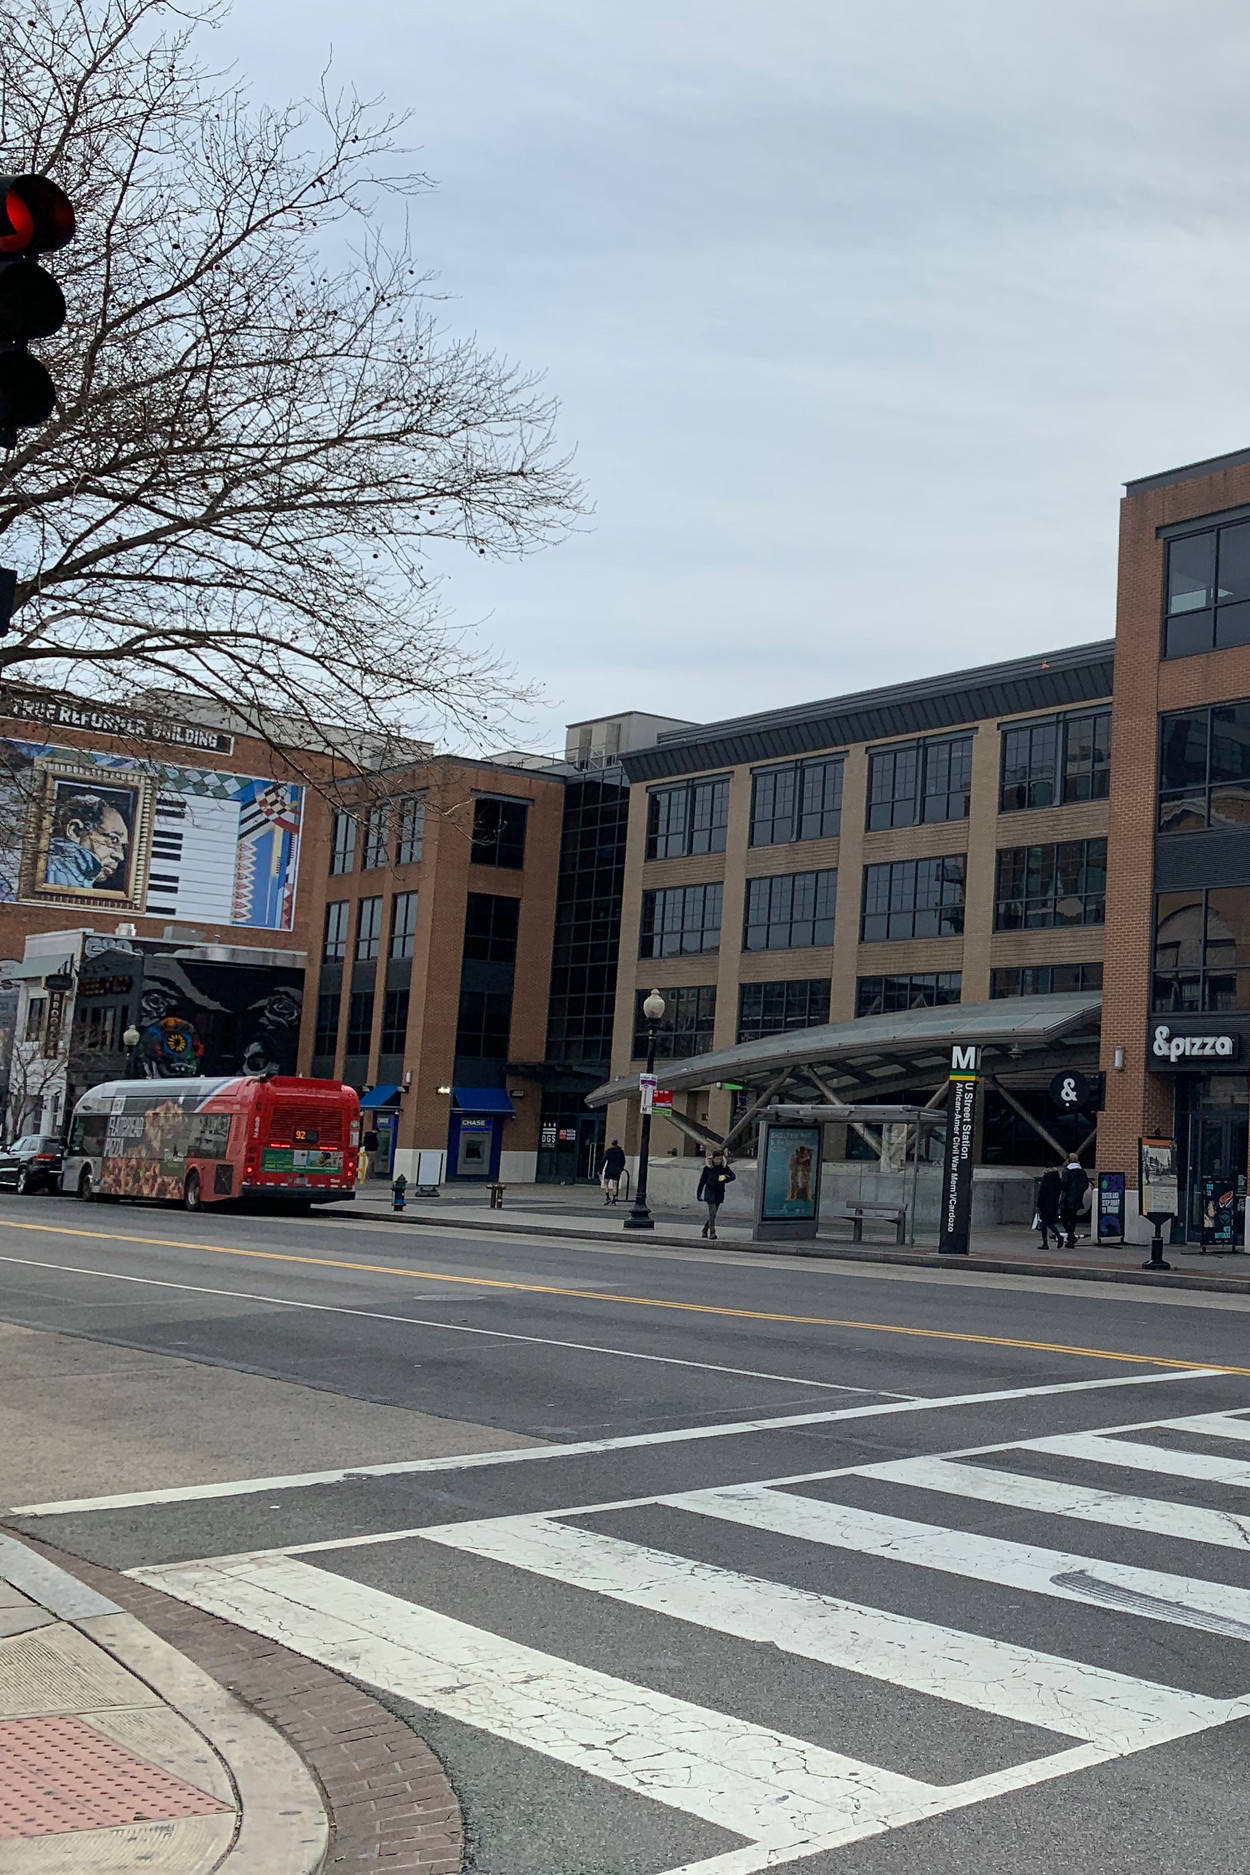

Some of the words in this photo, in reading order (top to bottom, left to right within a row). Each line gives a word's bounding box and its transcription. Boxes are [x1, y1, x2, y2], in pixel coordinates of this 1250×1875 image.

[11, 698, 57, 721] TRUE
[58, 705, 147, 736] REFORMER
[151, 720, 218, 748] BUILDING
[1153, 1025, 1233, 1063] &pizza
[951, 1045, 976, 1070] M
[964, 1082, 974, 1090] U
[953, 1082, 964, 1135] African-Amer
[962, 1092, 974, 1122] Street
[295, 1130, 306, 1140] 92
[541, 1134, 556, 1143] DGS
[952, 1136, 961, 1155] Civil
[960, 1124, 972, 1159] Station
[951, 1155, 960, 1172] War
